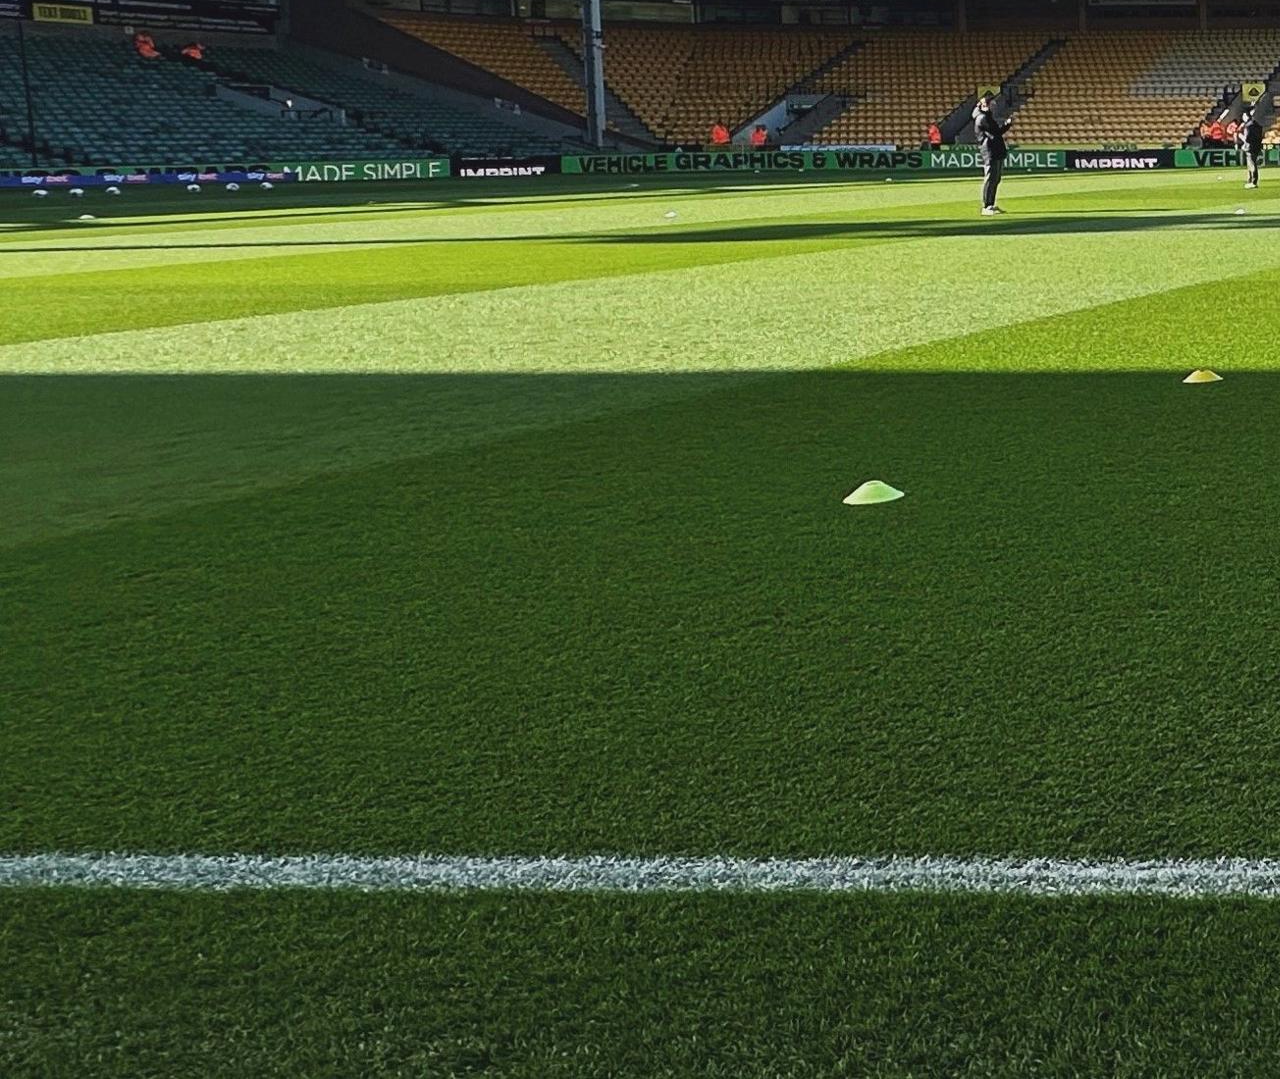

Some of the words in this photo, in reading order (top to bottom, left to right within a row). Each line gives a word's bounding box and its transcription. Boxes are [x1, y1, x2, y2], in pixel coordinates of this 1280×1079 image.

[579, 154, 668, 172] VEHICLE
[675, 151, 805, 170] GRAPHICS
[812, 151, 827, 169] &
[834, 151, 923, 169] WRAPS
[930, 150, 984, 169] MADE
[1003, 150, 1058, 168] IMPLE
